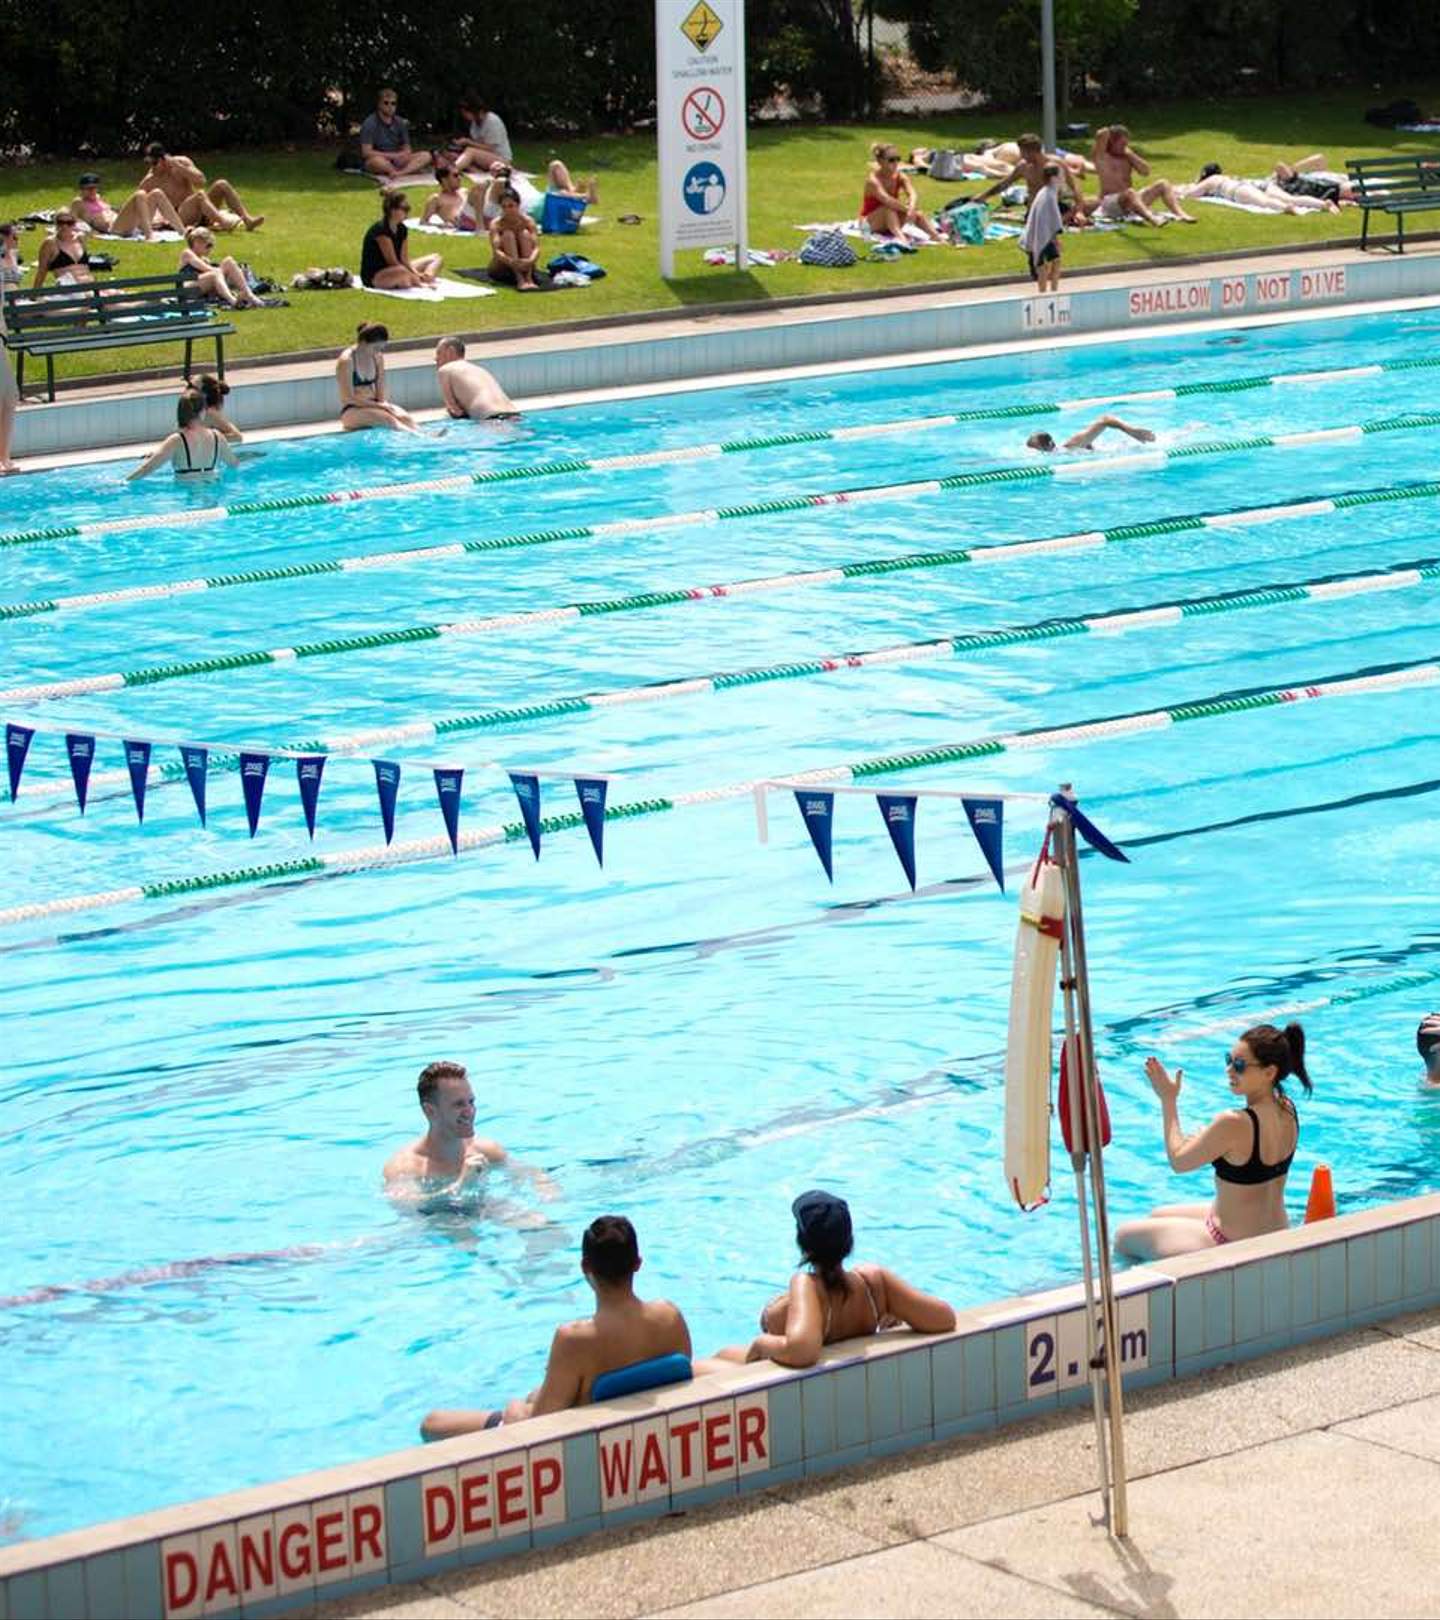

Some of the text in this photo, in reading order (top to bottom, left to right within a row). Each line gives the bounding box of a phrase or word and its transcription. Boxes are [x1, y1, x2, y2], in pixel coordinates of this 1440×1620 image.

[1130, 271, 1344, 314] SHALLOW DO NOT DIVE
[1024, 302, 1071, 327] 1.1m
[166, 1407, 768, 1611] DANGER DEEP WATER
